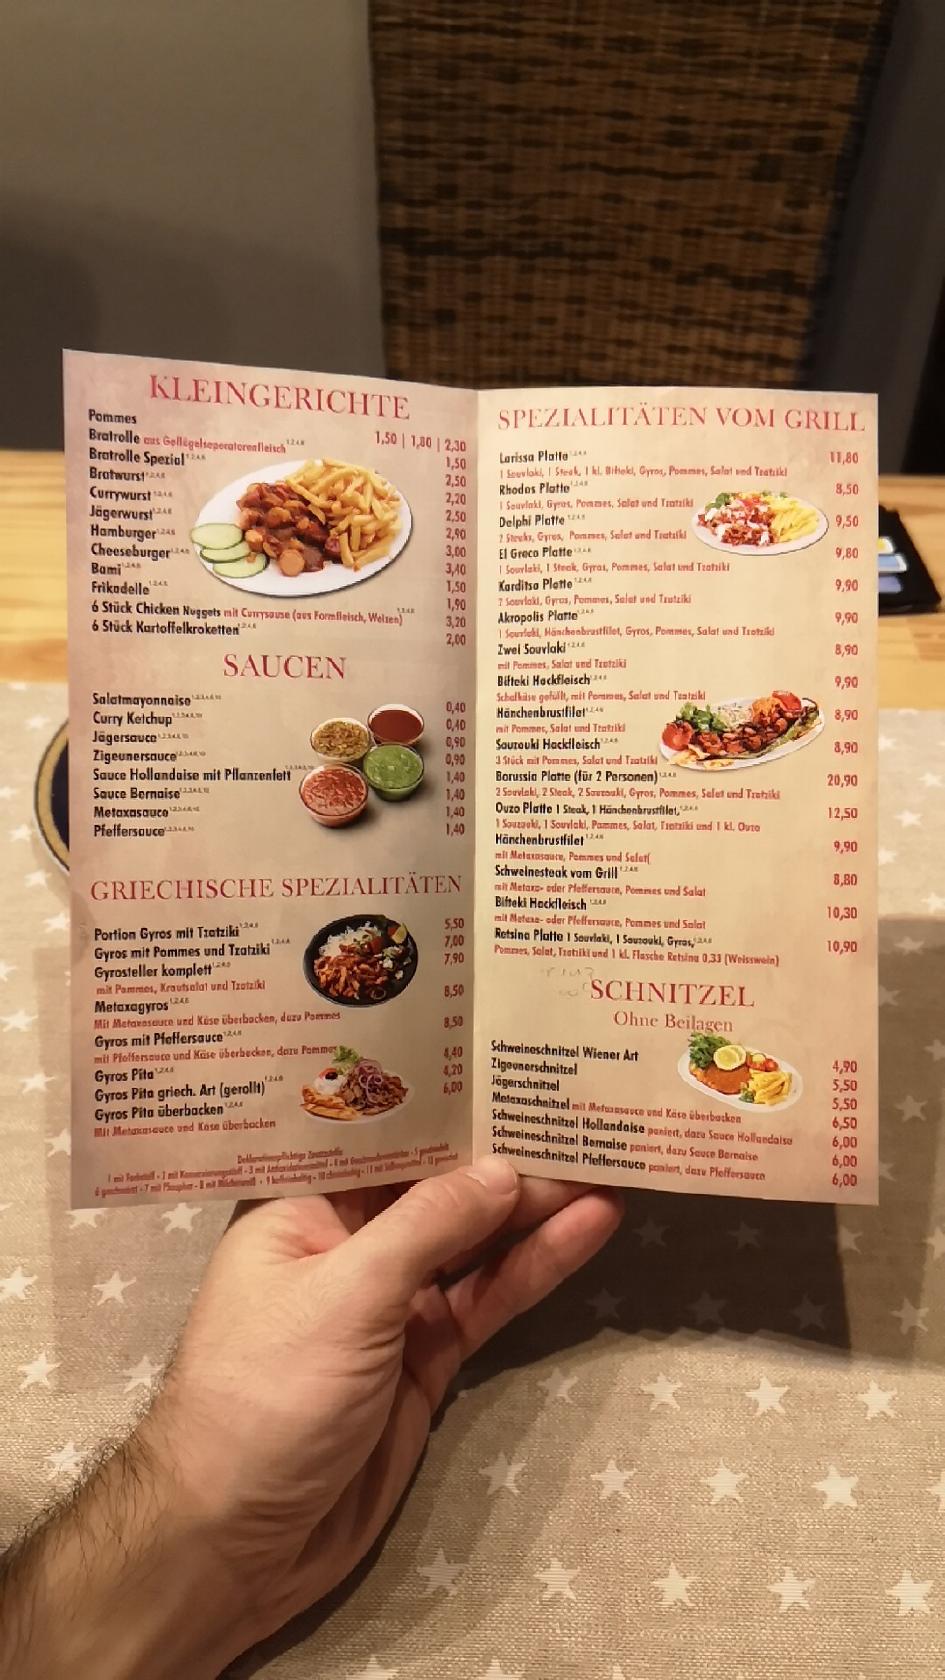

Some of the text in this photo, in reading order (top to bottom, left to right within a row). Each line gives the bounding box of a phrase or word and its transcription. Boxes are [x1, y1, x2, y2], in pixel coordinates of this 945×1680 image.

[149, 374, 410, 420] KLEINGERICHTE
[89, 409, 137, 425] Pommes
[498, 403, 865, 432] SPEZIALITÄTEN VOM GRILL
[89, 429, 140, 445] Bratrolle
[375, 431, 432, 448] 1,50 1,80
[90, 447, 185, 467] Bratrolle Spezial
[446, 456, 466, 470] 1,50
[500, 451, 568, 464] Larissa Platte
[829, 451, 859, 464] 11,80
[90, 467, 145, 482] Bratwurst
[90, 486, 151, 501] Currywurst
[500, 482, 570, 496] Rhodos Platte
[836, 483, 859, 496] 8,50
[446, 493, 466, 505] 2,20
[90, 505, 153, 521] Jägerwurst
[445, 510, 466, 523] 2,50
[500, 514, 565, 530] Delphi Platte
[91, 524, 156, 541] Hamburger
[91, 543, 170, 560] Cheeseburger
[446, 545, 466, 558] 3,00
[500, 546, 572, 559] El Greco Platte
[836, 547, 859, 560] 9,80
[91, 562, 121, 576] Bami
[91, 581, 150, 596] Frikadelle
[446, 580, 466, 593] 1,50
[542, 578, 572, 590] Platte
[102, 601, 132, 615] Stück
[136, 602, 179, 616] Chicken
[183, 605, 221, 620] Nuggets
[447, 598, 466, 611] 1,90
[498, 610, 577, 625] Akropolis Platte
[835, 612, 858, 625] 9,90
[102, 620, 239, 636] Stück Kartoffelkroketten
[446, 633, 466, 646] 2,00
[498, 642, 566, 655] Zwei Souvlaki
[835, 644, 858, 656] 8,90
[224, 653, 347, 679] SAUCEN
[498, 674, 590, 686] Bifteki Hackfleisch
[92, 693, 191, 708] Salatmayonnaise
[93, 712, 172, 727] Curry Ketchup
[835, 708, 858, 721] 8,90
[446, 719, 466, 732] 0,40
[93, 731, 157, 745] Jägersauce
[446, 736, 465, 749] 0,90
[543, 738, 600, 750] Hackfleisch
[93, 750, 177, 765] Zigeunersauce
[93, 769, 126, 781] Sauce
[130, 769, 199, 781] Hollandaise
[203, 769, 221, 781] mit
[446, 771, 465, 783] 1,40
[496, 771, 658, 784] Borussia Platte (für Personen)
[828, 774, 858, 787] 20,90
[93, 787, 180, 799] Sauce Bernaise
[93, 806, 168, 818] Metaxasauce
[446, 806, 465, 819] 1,40
[496, 802, 552, 814] Ouzo Platte
[828, 807, 858, 820] 12,50
[94, 825, 165, 837] Pfeffersauce
[446, 823, 465, 837] 1,40
[570, 868, 592, 878] vom
[595, 867, 617, 879] Grill
[91, 872, 462, 902] GRIECHISCHE SPEZIALITÄTEN
[833, 874, 857, 887] 8,80
[495, 897, 586, 910] Bifteki Hackfleisch
[95, 925, 239, 943] Portion Gyros mit Tzatziki
[495, 928, 563, 942] Retsina Platte
[445, 935, 464, 949] 7,00
[827, 940, 857, 953] 10,90
[95, 944, 270, 962] Gyros mit Pommes und Tzatziki
[95, 963, 212, 980] Gyrosteller komplett
[444, 985, 464, 998] 8,50
[590, 978, 755, 1008] SCHNITZEL
[95, 999, 168, 1015] Metaxagyros
[444, 1016, 463, 1029] 8,50
[614, 1011, 733, 1033] Ohne Beilagen
[95, 1031, 223, 1050] Gyros mit Pfeffersauce
[492, 1040, 639, 1062] Schweineschnitzel Wiener Art
[444, 1064, 463, 1077] 4,20
[832, 1060, 857, 1073] 4,90
[95, 1068, 154, 1084] Gyros Pita
[131, 1081, 265, 1100] Pita griech. Art (gerollt)
[492, 1075, 559, 1092] Jägerschnitzel
[492, 1092, 570, 1110] Metaxaschnitzel
[832, 1098, 857, 1111] 5,50
[132, 1103, 223, 1119] Pita überbacken
[492, 1109, 579, 1129] Schweineschnitzel
[582, 1116, 645, 1134] Hollandaise
[492, 1126, 627, 1151] Schweineschnitzel Bernaise
[832, 1136, 857, 1149] 6,00
[492, 1143, 646, 1170] Schweineschnitzel Pfeffersauce
[832, 1155, 857, 1168] 6,00
